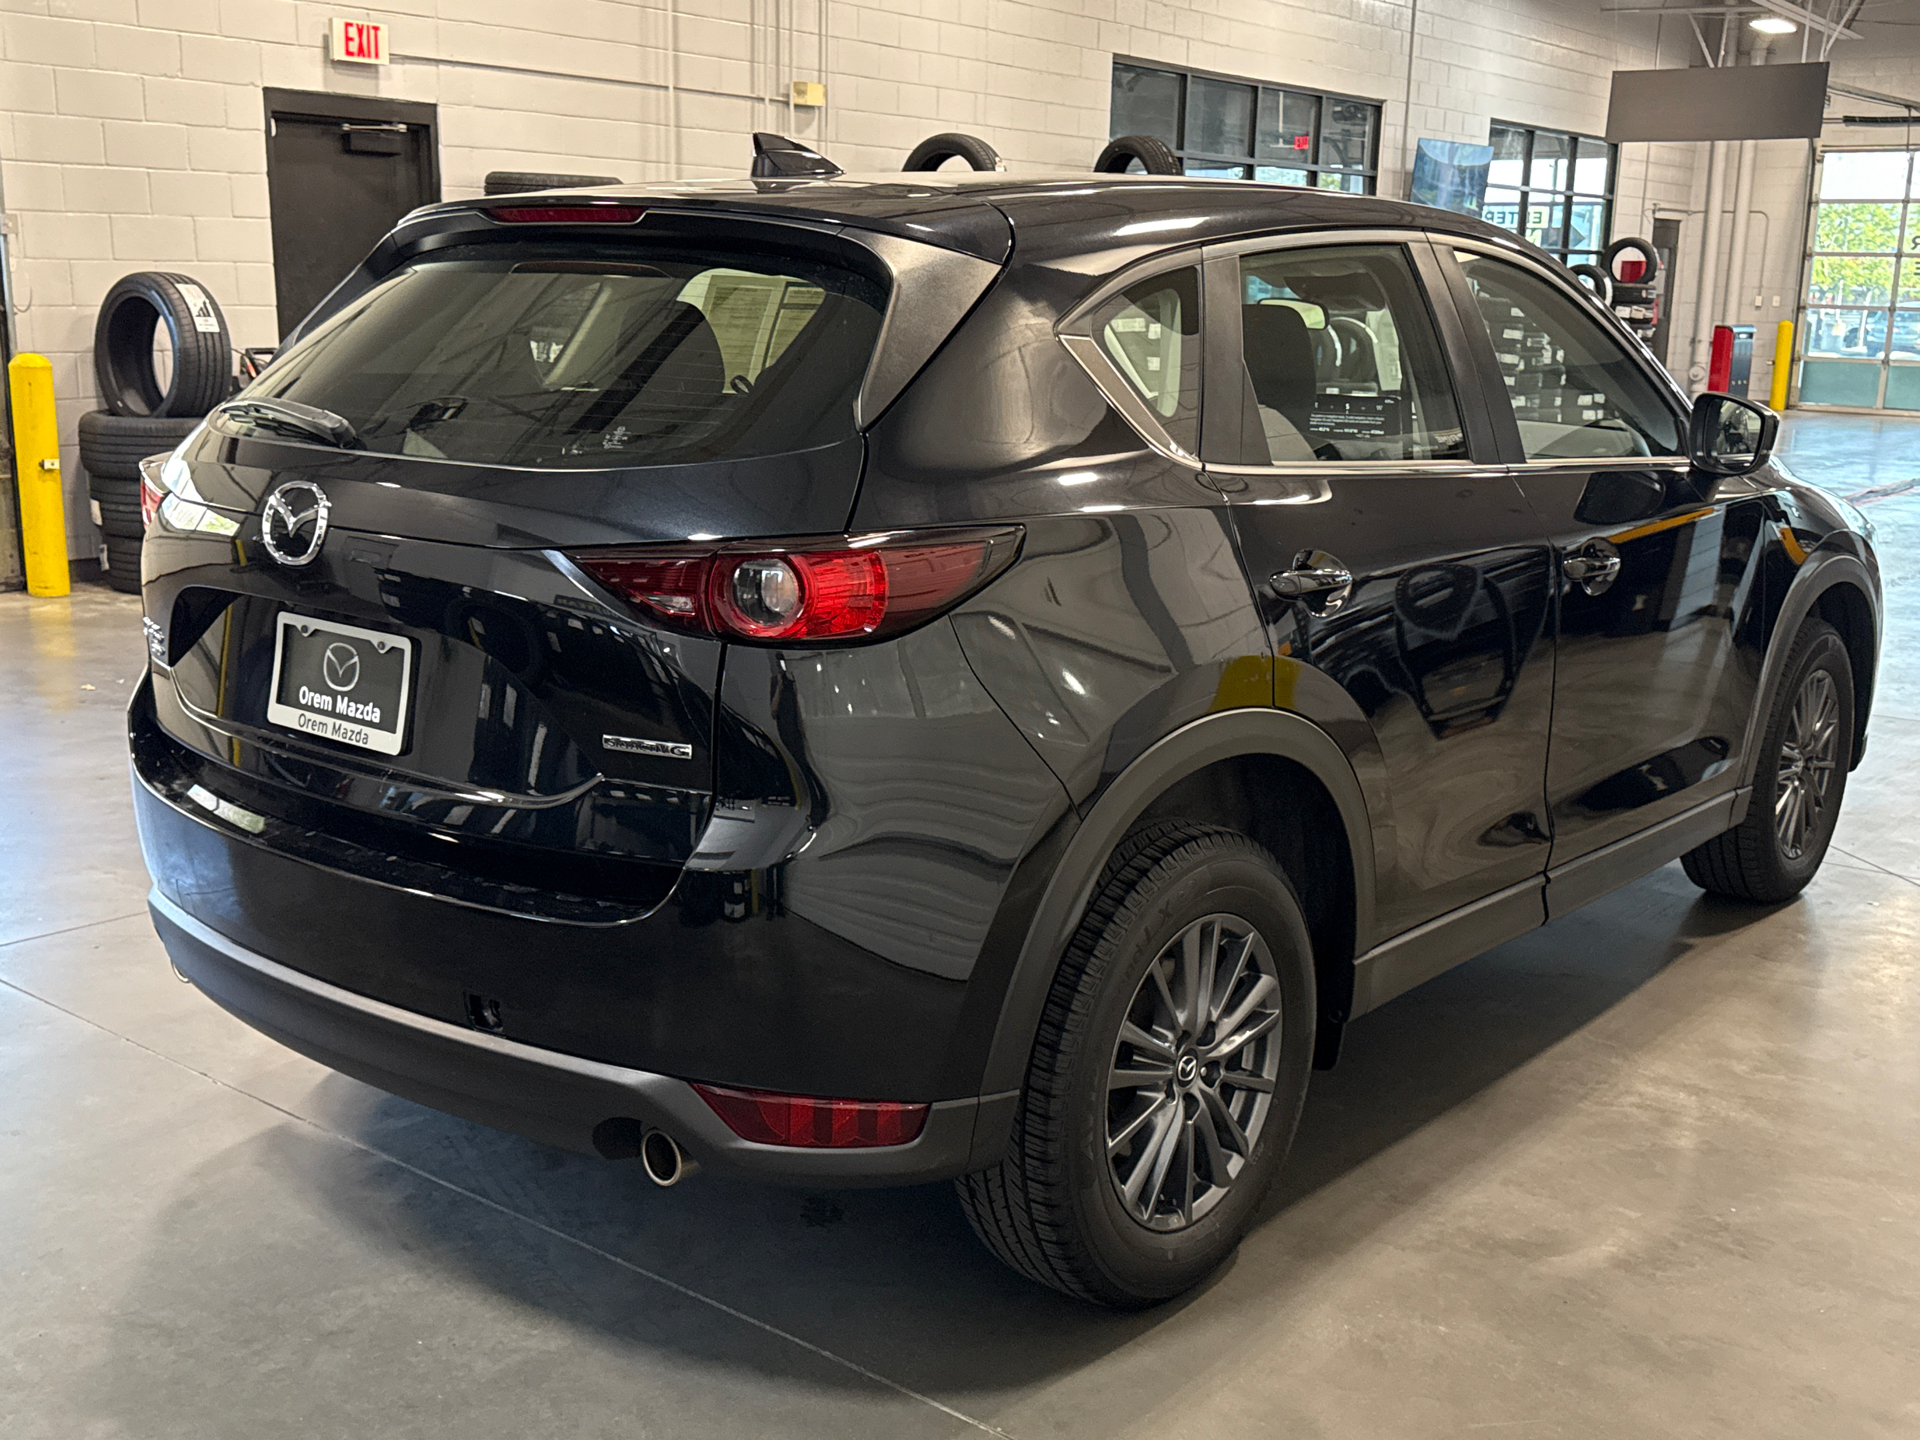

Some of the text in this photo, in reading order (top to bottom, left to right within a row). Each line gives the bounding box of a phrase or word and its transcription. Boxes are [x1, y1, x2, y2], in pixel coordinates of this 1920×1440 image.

[344, 21, 381, 60] EXIT
[299, 685, 381, 723] Orem Mazda
[297, 713, 369, 745] Orem Mazda
